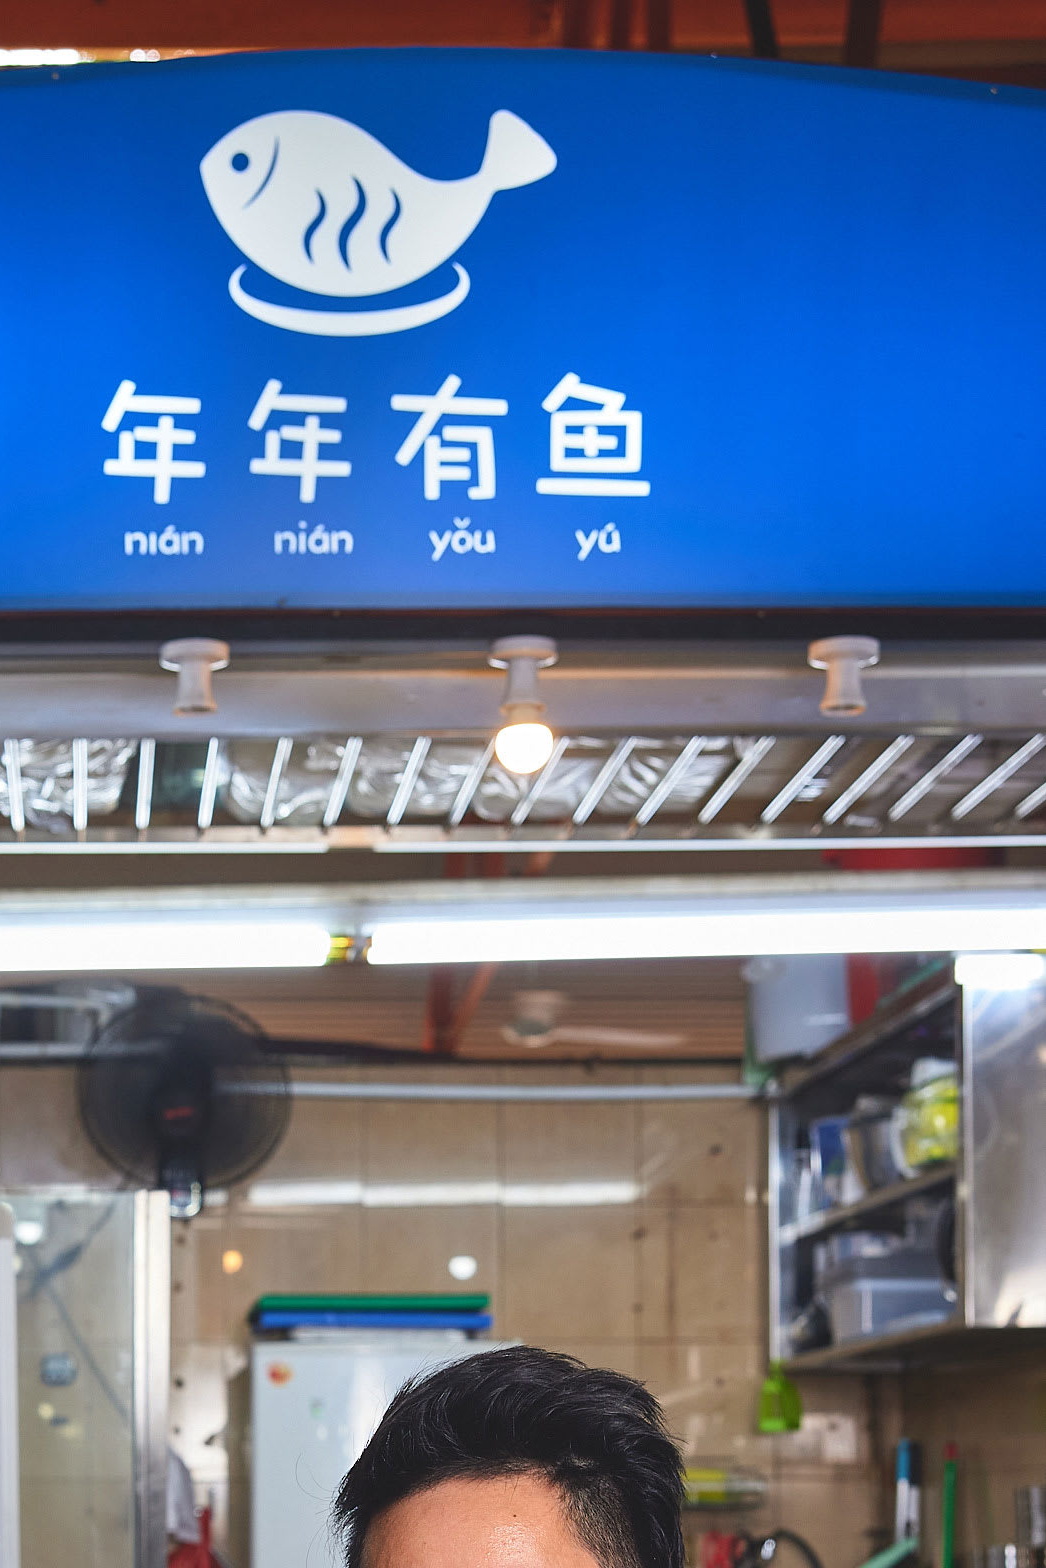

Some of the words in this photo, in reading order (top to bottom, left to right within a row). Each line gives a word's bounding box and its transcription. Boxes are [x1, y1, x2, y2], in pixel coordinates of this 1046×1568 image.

[101, 371, 651, 504] 年年有鱼
[273, 520, 354, 556] nián
[575, 522, 622, 561] yú
